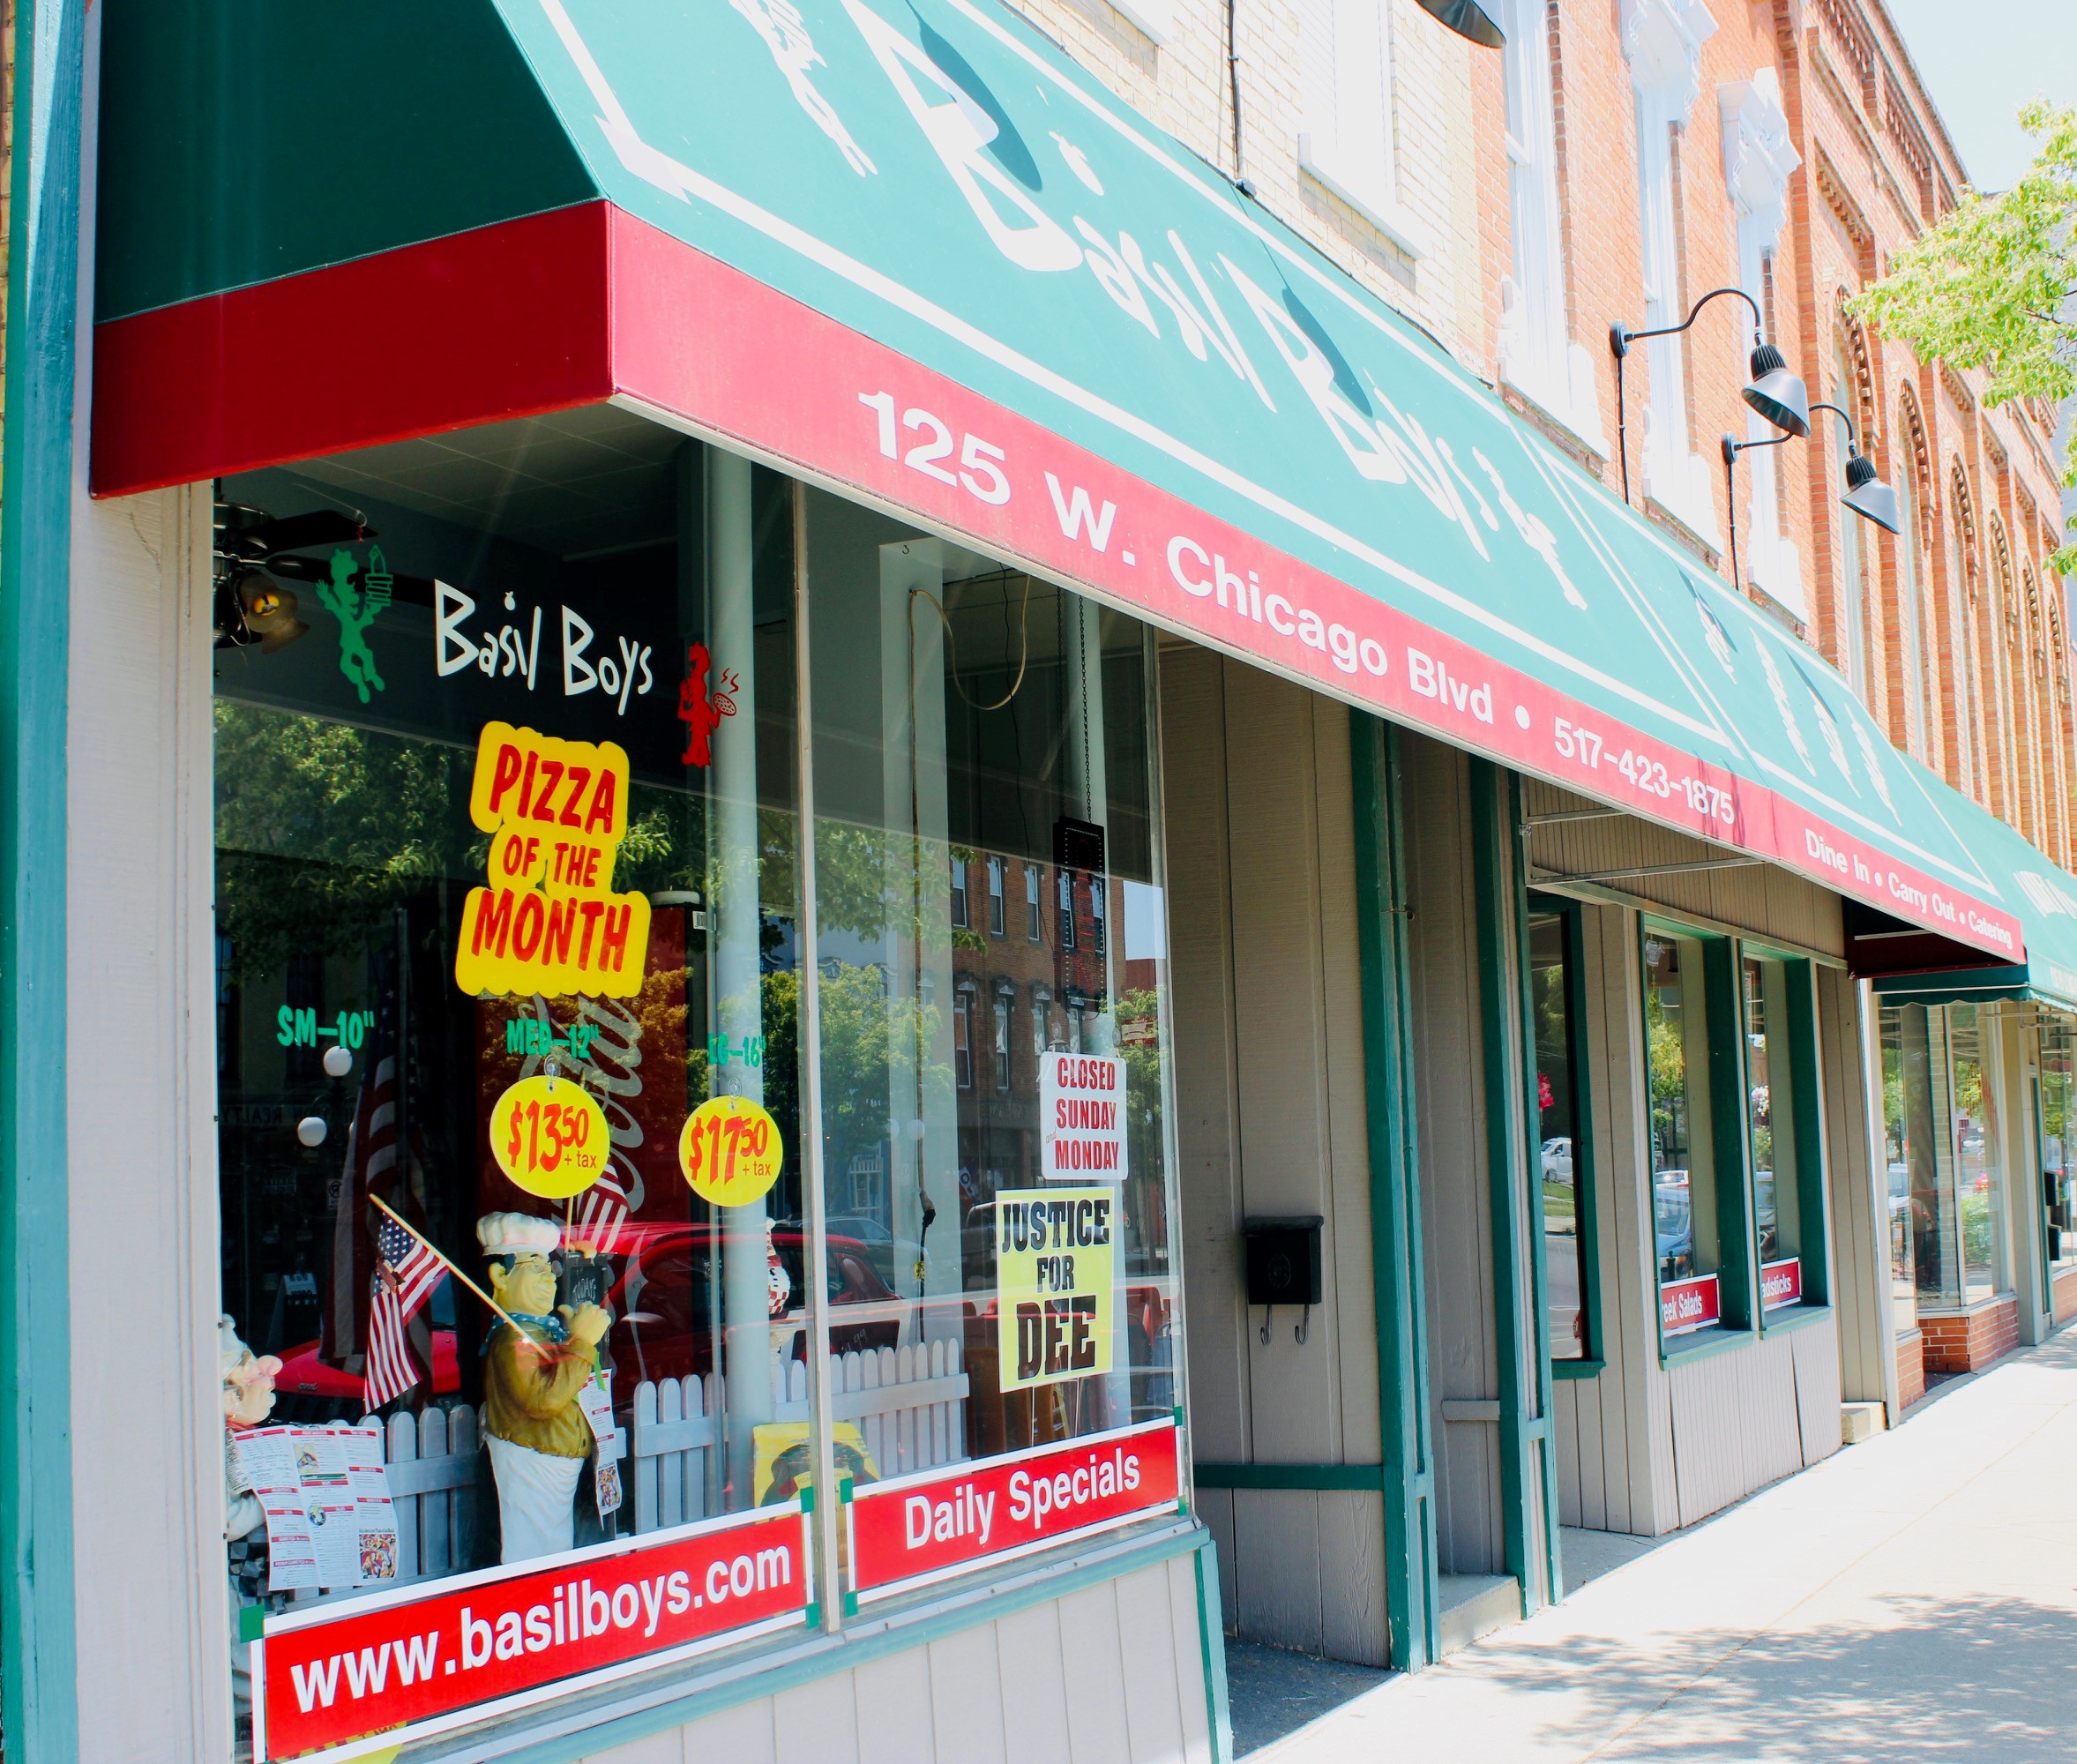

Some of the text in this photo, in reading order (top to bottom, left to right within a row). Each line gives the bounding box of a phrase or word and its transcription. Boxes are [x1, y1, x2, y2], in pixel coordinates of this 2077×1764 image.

[840, 0, 1499, 562] Basil Boys
[434, 579, 653, 716] Basil Boys
[858, 390, 1012, 505] 125
[1044, 471, 1136, 567] W.
[1167, 534, 1389, 676] Chicago
[1407, 647, 1495, 725] Blvd
[1554, 716, 1736, 826] 517-423-1875
[1804, 828, 1849, 873] Dine
[1853, 854, 1871, 885] In
[1888, 871, 1928, 914] Carry
[1931, 893, 1956, 923] Out
[1968, 909, 2013, 950] Catering
[489, 744, 616, 834] PIZZA
[503, 834, 601, 887] OF THE
[471, 888, 631, 974] MONTH
[1057, 1058, 1116, 1090] CLOSED
[1056, 1098, 1117, 1130] SUNDAY
[576, 1150, 596, 1169] tax
[753, 1161, 772, 1176] tax
[1055, 1140, 1119, 1170] MONDAY
[1002, 1200, 1110, 1253] JUSTICE
[1036, 1255, 1075, 1293] FOR
[1761, 1273, 1792, 1298] adsticks
[1678, 1289, 1703, 1318] Salads
[1016, 1295, 1096, 1381] DEE
[905, 1447, 1140, 1551] Daily Specials
[290, 1544, 791, 1714] www.basilboys.com
